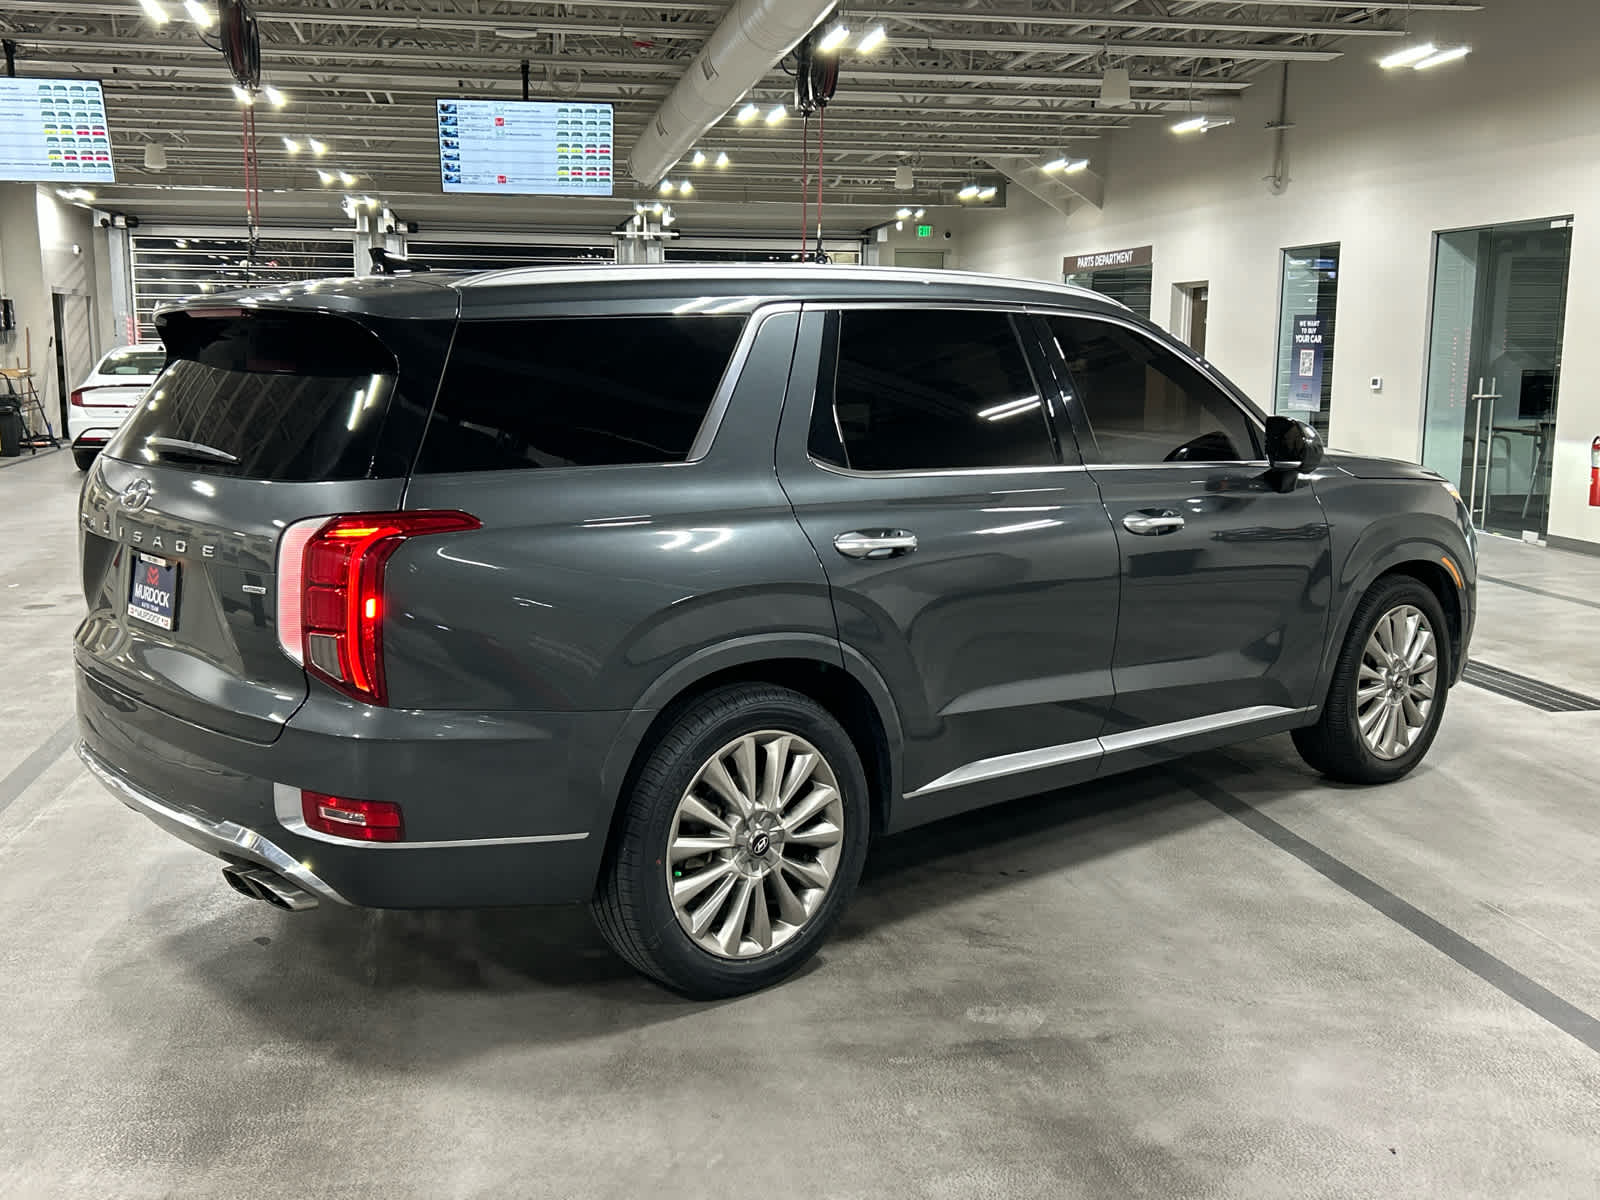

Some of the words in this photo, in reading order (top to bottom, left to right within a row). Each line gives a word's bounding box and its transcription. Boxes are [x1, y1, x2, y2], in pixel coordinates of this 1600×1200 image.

[1077, 255, 1094, 268] PARTS
[1095, 250, 1133, 266] DEPARTMENT
[1295, 334, 1310, 343] YOUR
[1310, 334, 1322, 343] CAR
[134, 582, 170, 609] MURDOCK
